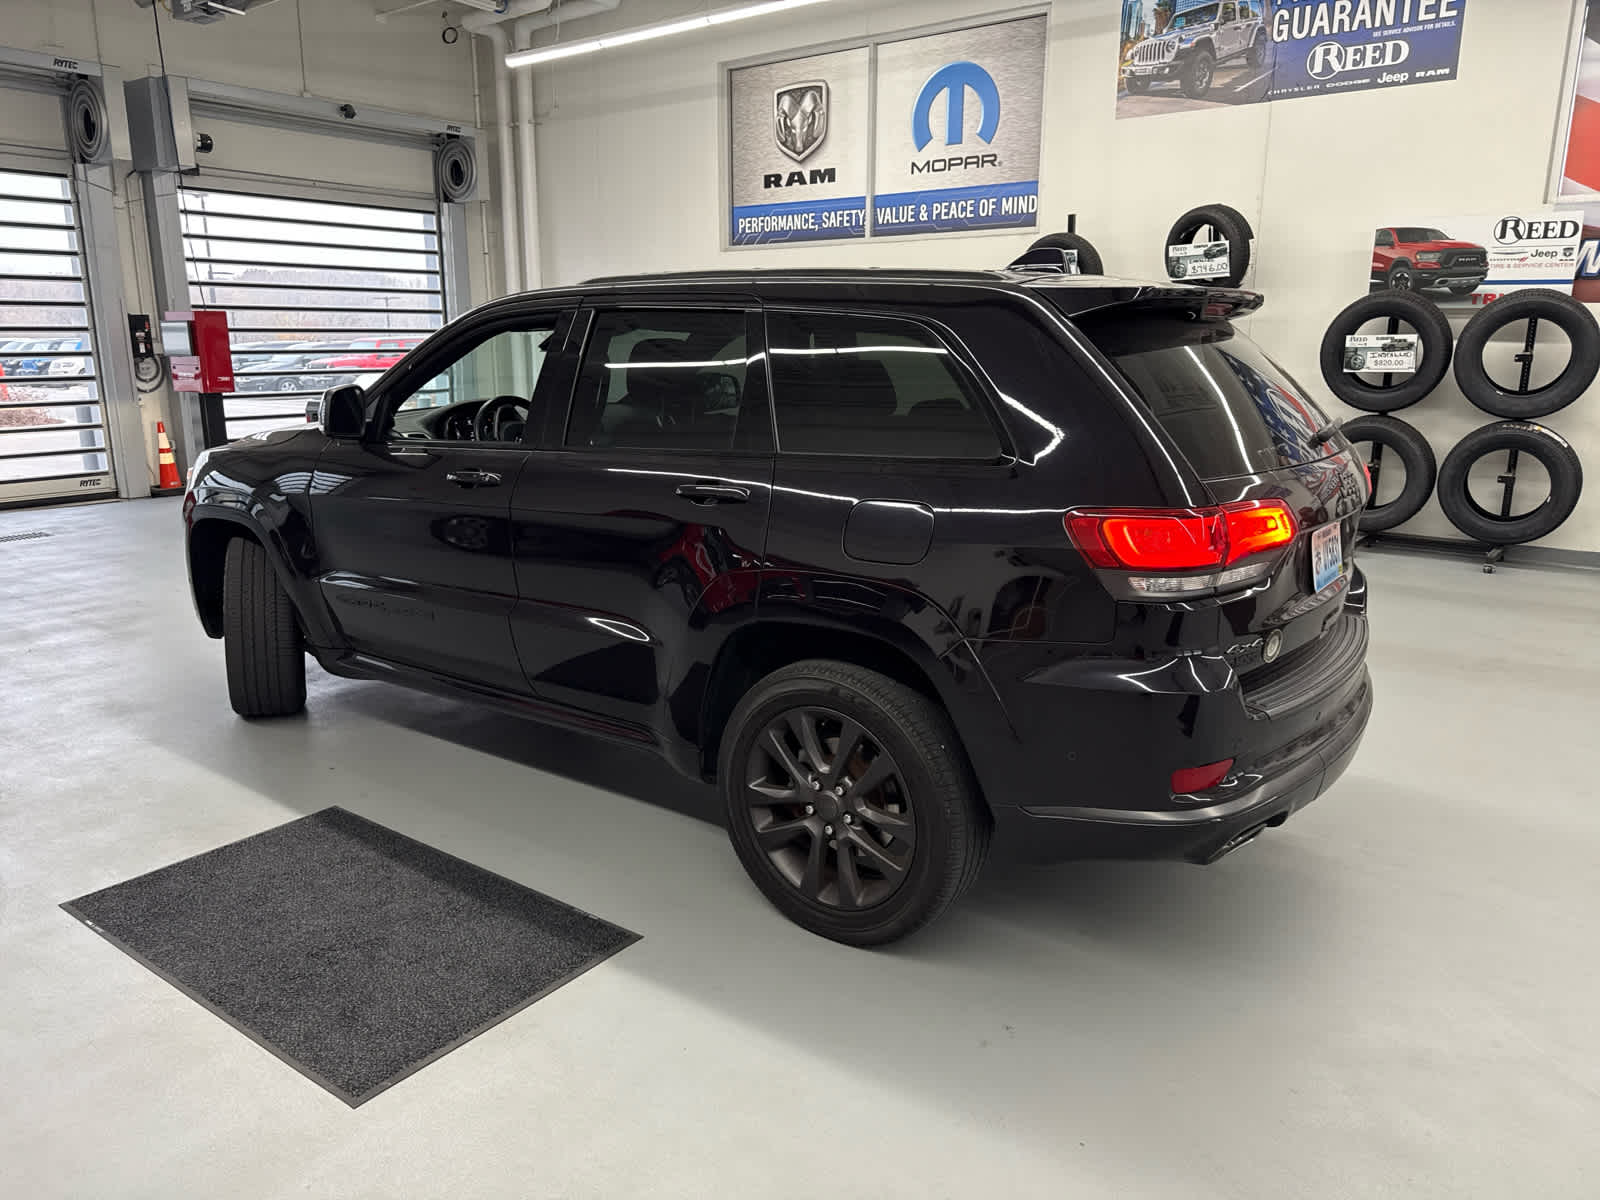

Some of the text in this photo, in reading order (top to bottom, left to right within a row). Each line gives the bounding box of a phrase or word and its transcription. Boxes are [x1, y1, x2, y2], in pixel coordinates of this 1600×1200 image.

[1272, 0, 1458, 43] GUARANTEE
[1383, 28, 1401, 36] SERVICE
[1307, 40, 1409, 79] REED
[1267, 84, 1320, 96] CHRYSLER
[1377, 71, 1409, 84] Jeep
[1415, 67, 1450, 78] RAM
[763, 167, 836, 189] RAM
[738, 212, 819, 234] PERFORMANCE,
[877, 205, 916, 225] VALUE
[919, 203, 929, 221] &
[932, 199, 975, 220] PEACE
[979, 198, 997, 217] OF
[1001, 194, 1038, 216] MIND
[1494, 216, 1580, 245] REED
[1530, 249, 1559, 259] Jeep
[1374, 359, 1404, 367] $820.00
